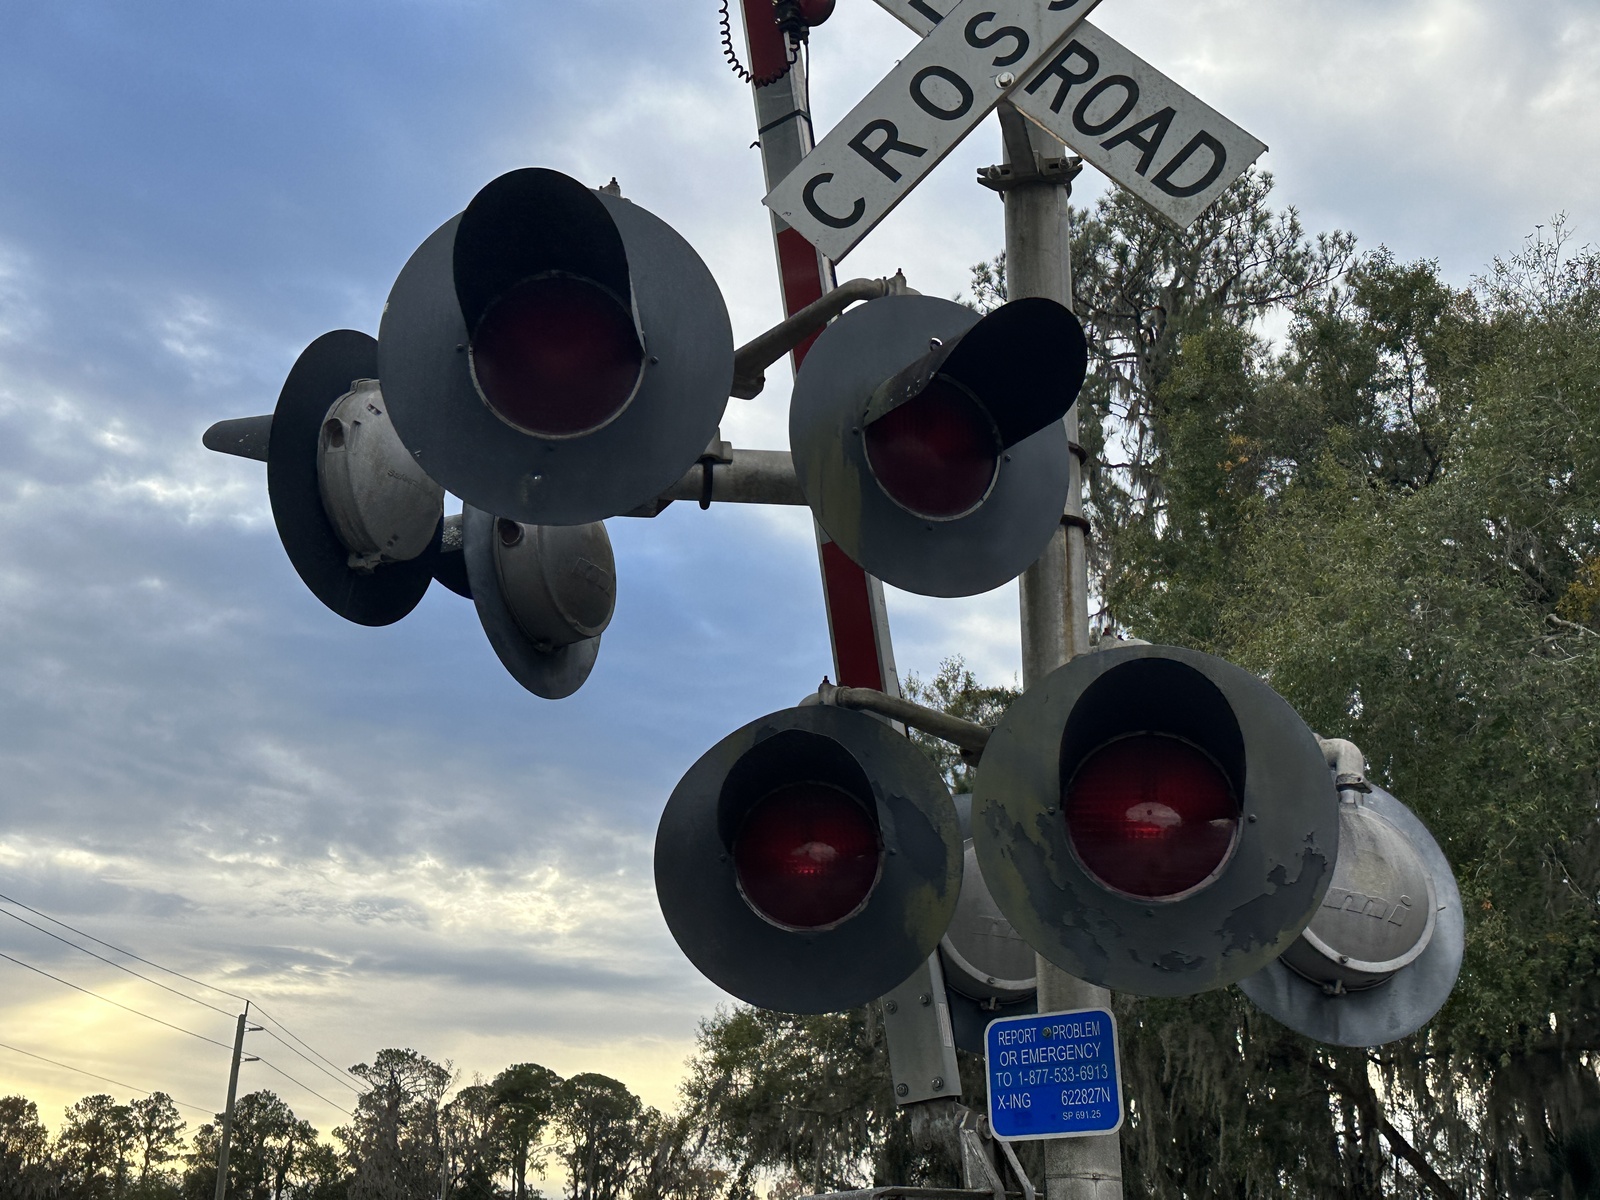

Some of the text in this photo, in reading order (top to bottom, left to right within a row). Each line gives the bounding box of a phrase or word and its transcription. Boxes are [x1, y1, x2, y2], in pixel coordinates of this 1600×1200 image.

[802, 0, 1080, 229] CROS
[1024, 39, 1227, 198] ROAD
[998, 1021, 1100, 1046] REPORT PROBLEM
[1000, 1042, 1101, 1066] OR EMERGENCY
[996, 1064, 1109, 1087] TO 1-877-533-6913
[997, 1087, 1111, 1110] X-ING 622827N
[1062, 1109, 1102, 1120] SP 691.25
